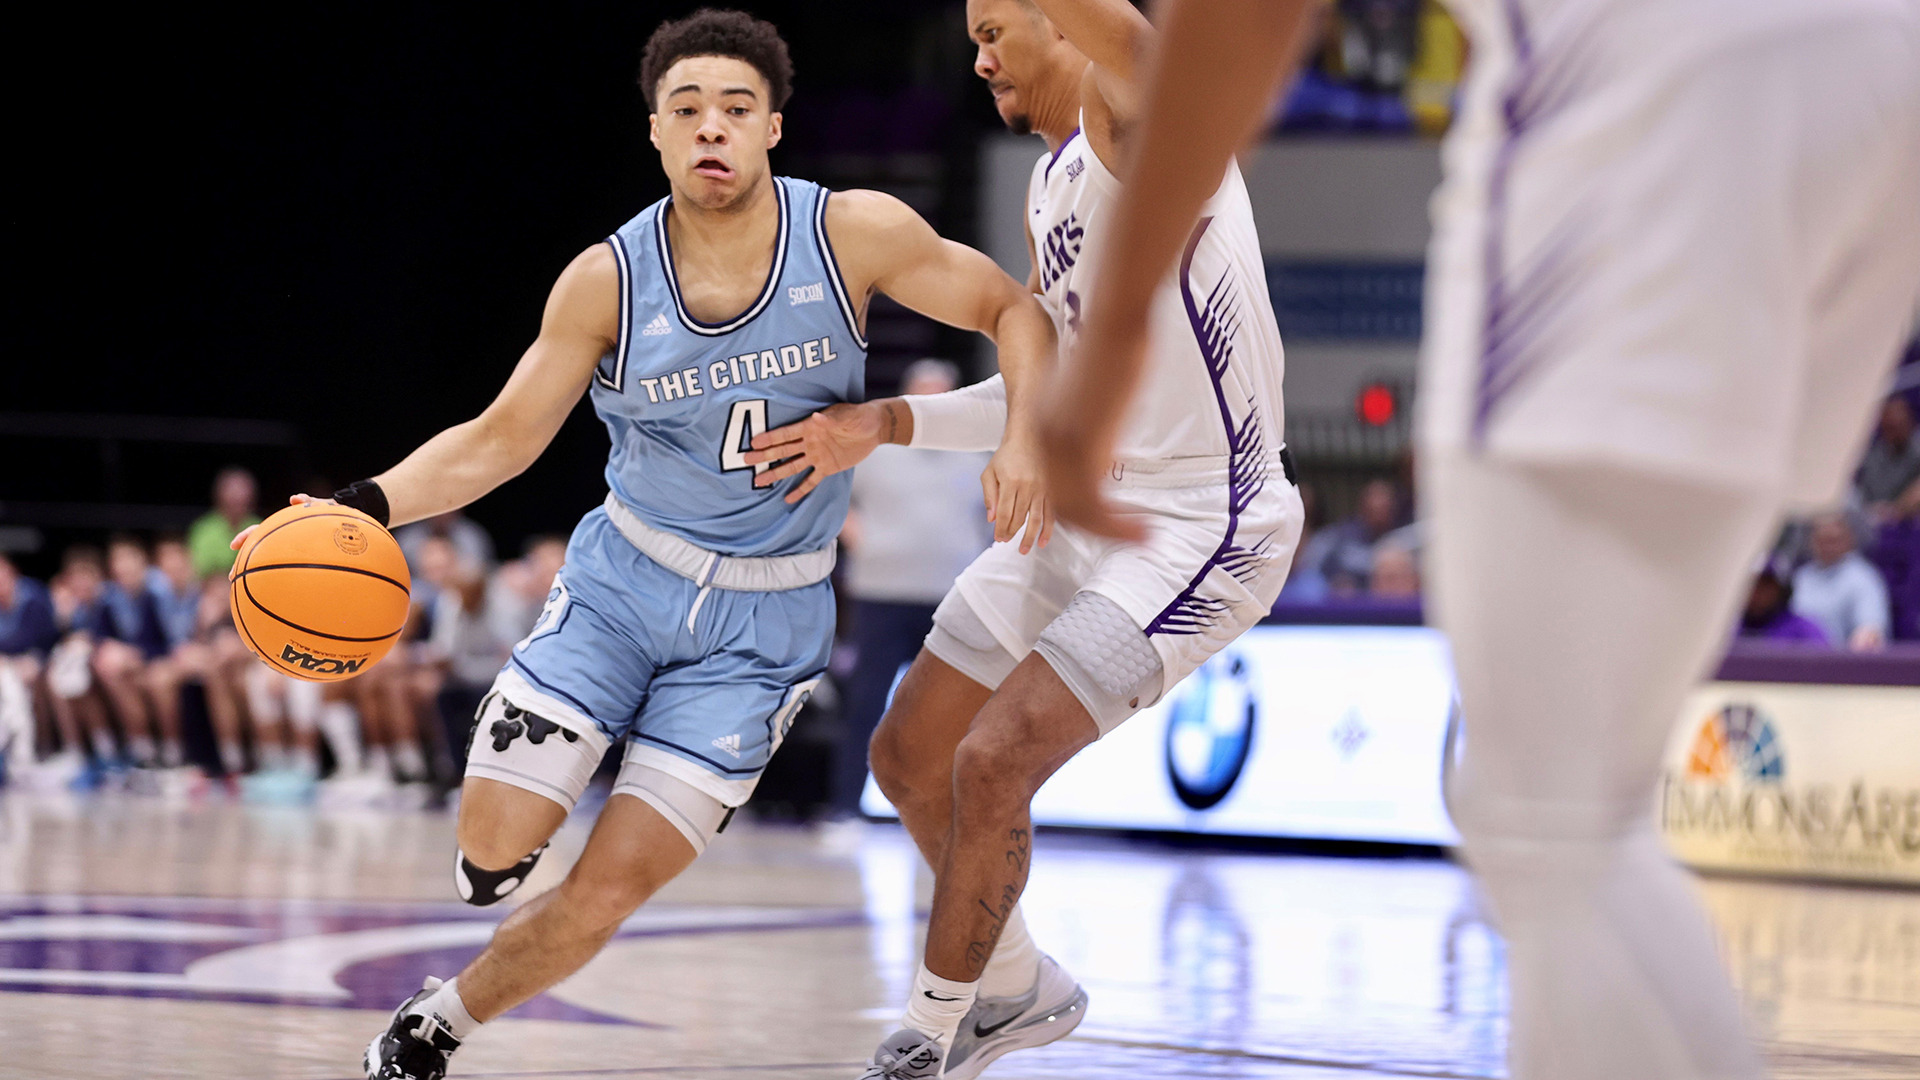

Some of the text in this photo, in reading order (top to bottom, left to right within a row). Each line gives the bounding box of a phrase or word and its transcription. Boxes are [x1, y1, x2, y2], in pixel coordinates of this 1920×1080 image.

[788, 282, 824, 306] SOCON
[639, 336, 838, 404] THE CITADEL
[718, 398, 782, 490] 4
[281, 643, 368, 674] NCAA
[290, 638, 311, 652] BALL
[1006, 828, 1029, 873] 23
